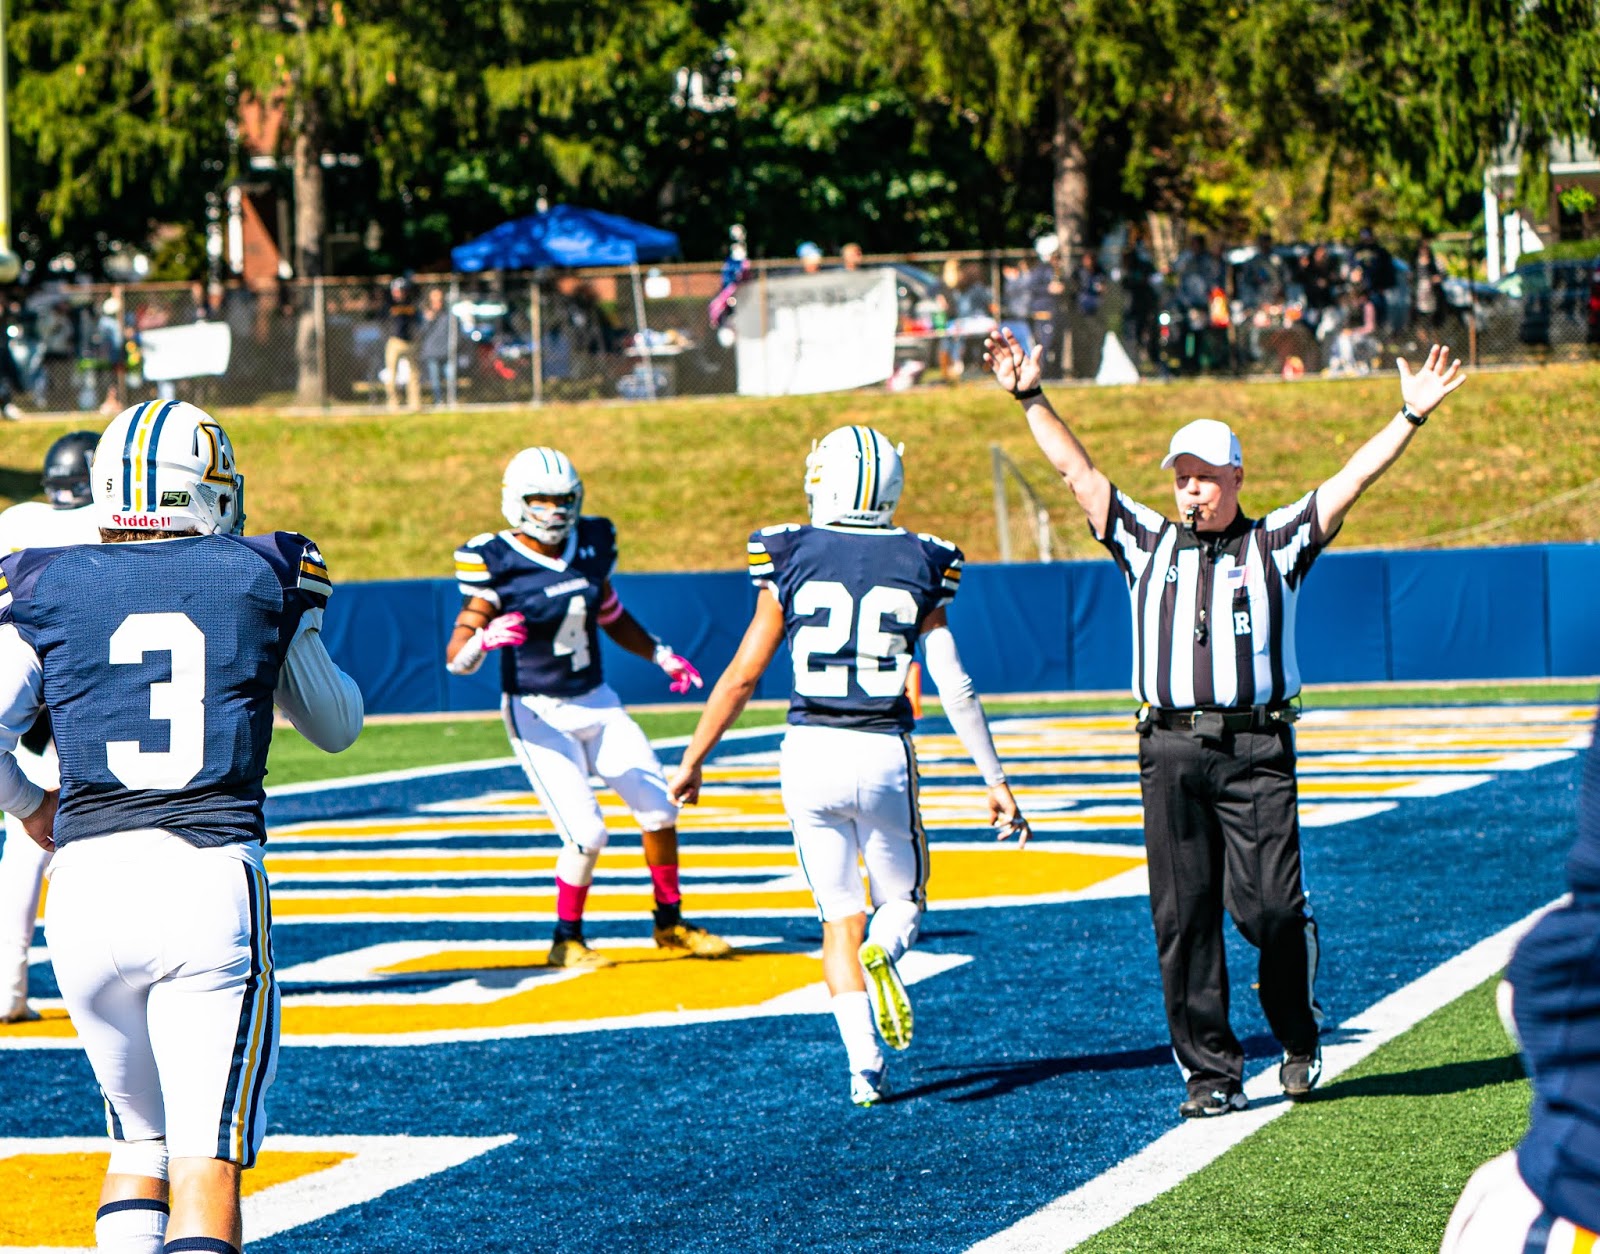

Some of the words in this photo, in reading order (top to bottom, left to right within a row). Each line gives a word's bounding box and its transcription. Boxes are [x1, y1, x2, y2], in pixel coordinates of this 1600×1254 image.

[112, 514, 171, 528] Riddell
[163, 492, 190, 506] 150
[553, 594, 591, 672] 4
[791, 580, 919, 697] 26
[1233, 611, 1252, 635] R
[106, 612, 206, 790] 3
